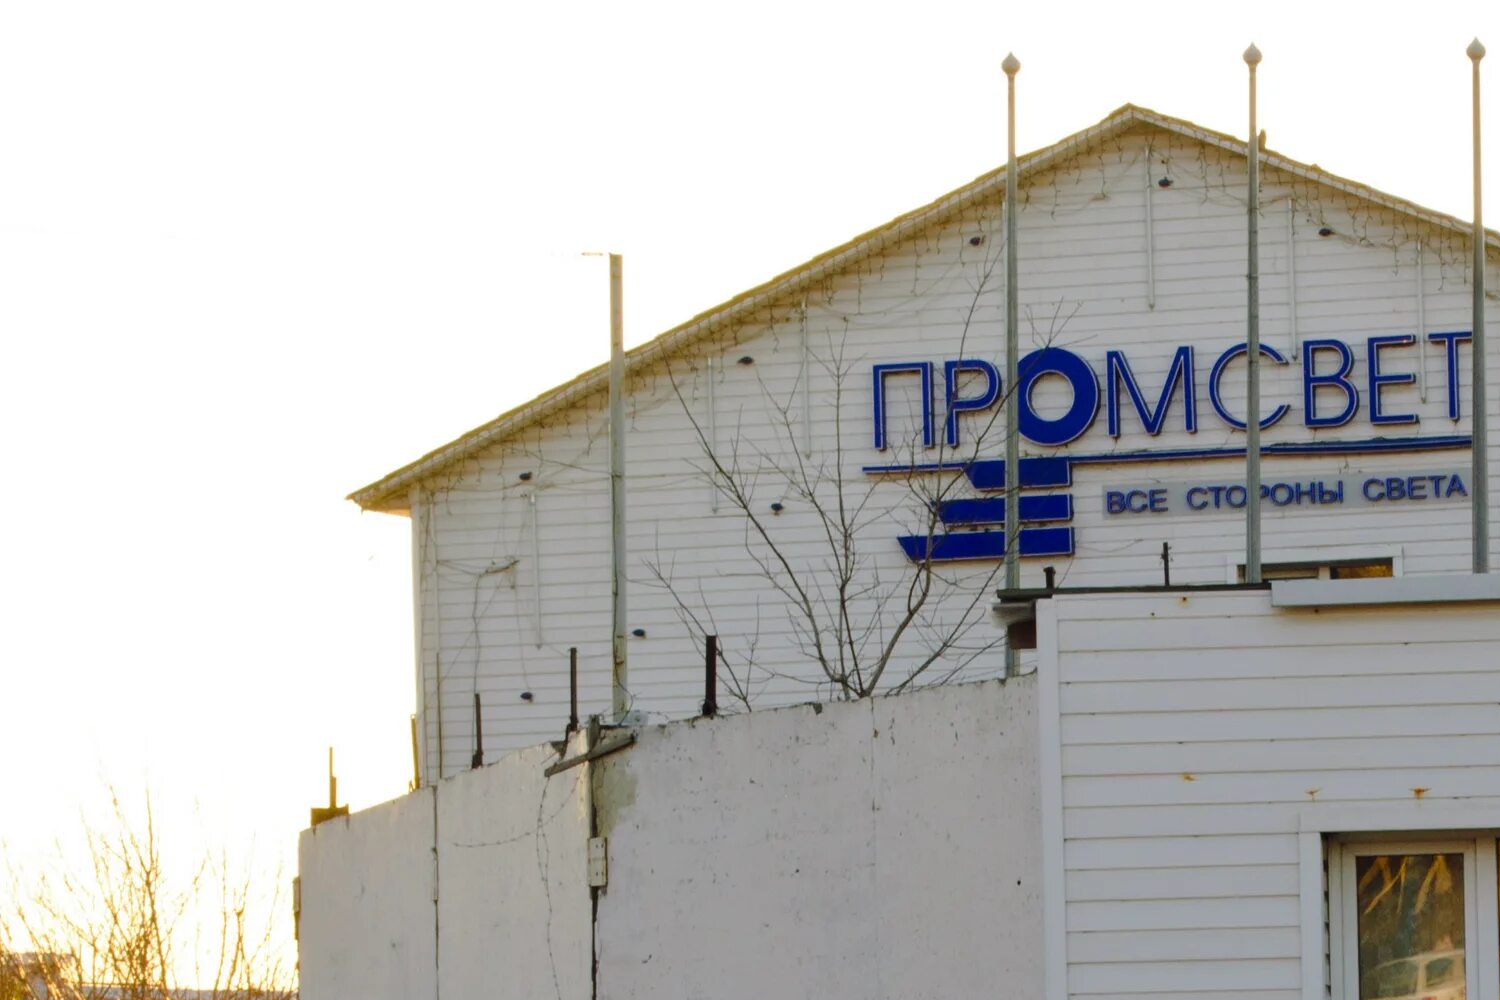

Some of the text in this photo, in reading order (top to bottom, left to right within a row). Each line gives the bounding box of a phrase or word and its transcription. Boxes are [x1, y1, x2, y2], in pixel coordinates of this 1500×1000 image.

[872, 331, 1473, 451] ПРОМСВЕТ
[1106, 488, 1168, 514] ВСЕ
[1362, 474, 1468, 501] СВЕТА
